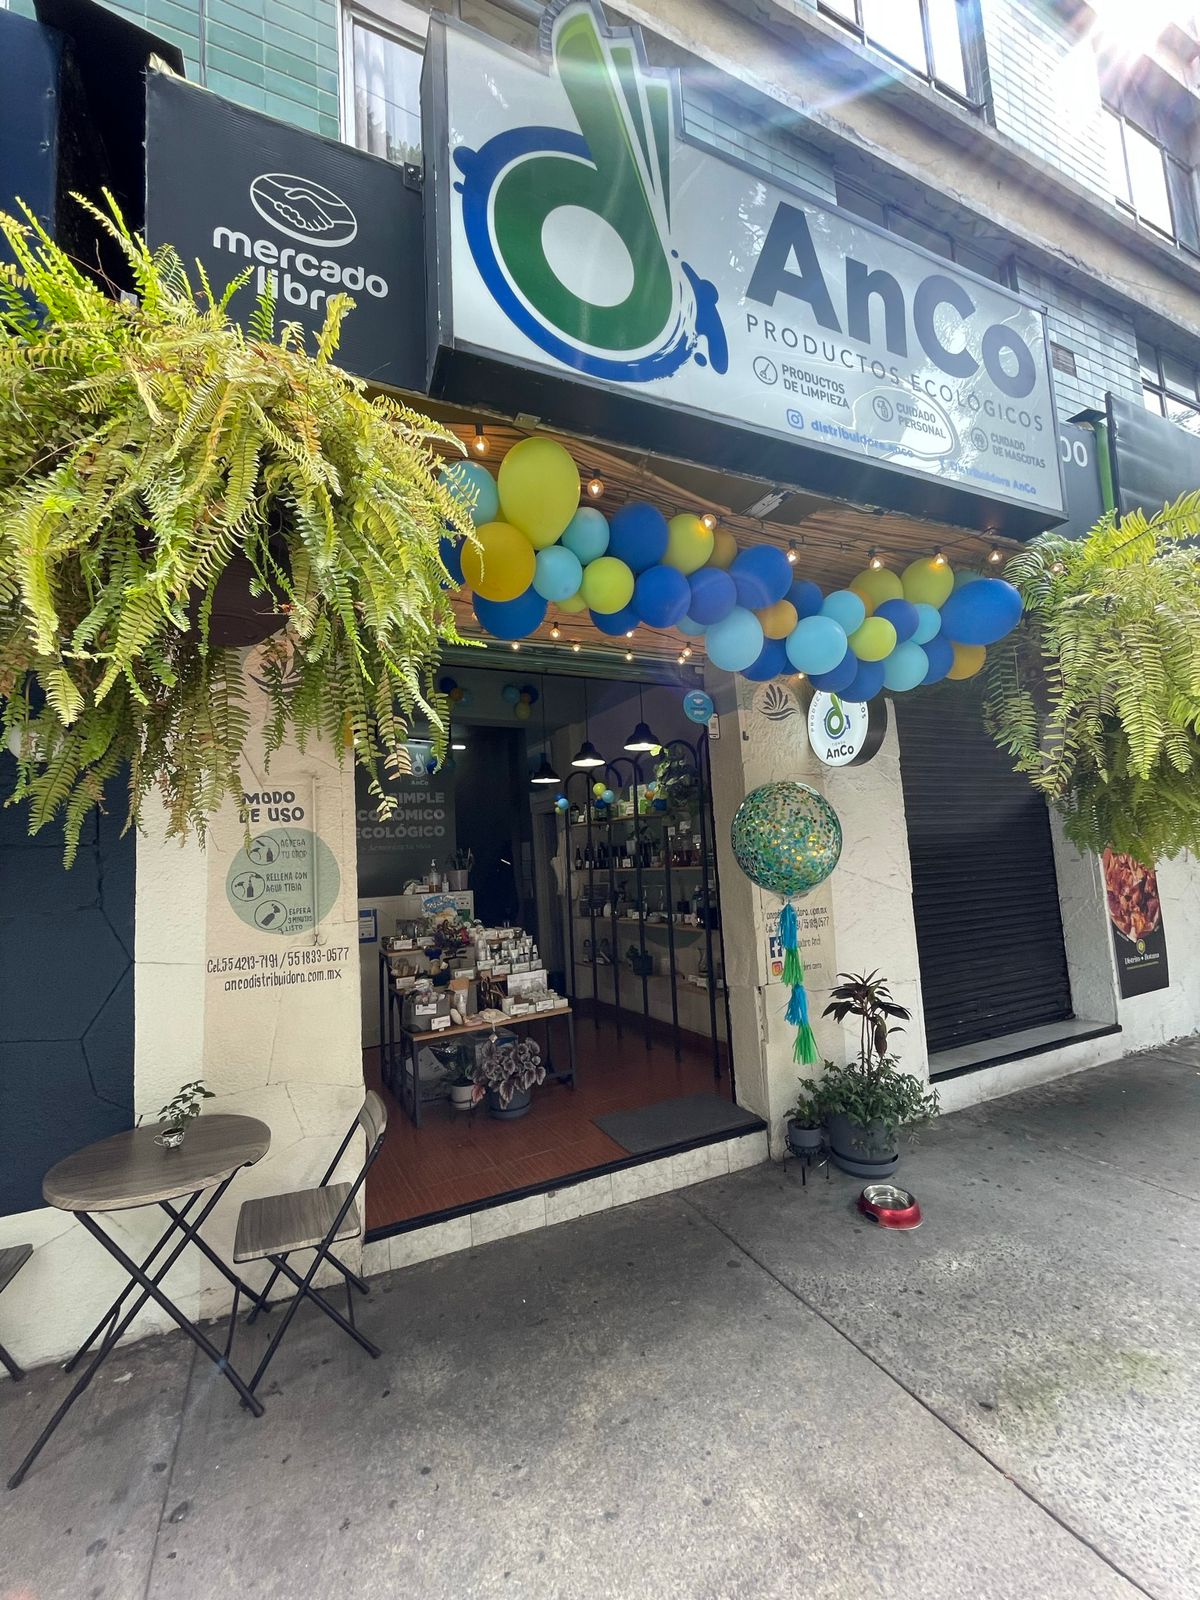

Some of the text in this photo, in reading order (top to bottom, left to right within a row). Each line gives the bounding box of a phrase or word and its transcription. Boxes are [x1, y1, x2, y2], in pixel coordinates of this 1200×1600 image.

[212, 226, 389, 298] mercado
[745, 200, 1036, 398] AnCo
[746, 313, 1043, 431] PRODUCTOS ECOLÓGICOS
[782, 363, 845, 394] PRODUCTOS
[783, 378, 850, 410] DE LIMPIEZA
[896, 402, 936, 424] CUIDADO
[898, 416, 947, 440] PERSONAL
[990, 433, 1025, 451] CUIDADO
[992, 445, 1046, 469] DE MASCOTAS
[826, 744, 855, 760] AnCo
[241, 790, 296, 805] MODO
[239, 807, 305, 823] DE USO
[265, 871, 308, 882] RELLENA CON
[265, 883, 303, 893] AGUA TIBIA
[288, 906, 311, 916] ESPERA
[285, 924, 303, 932] LISTO
[224, 968, 342, 992] ancodistribuidora.com.mx
